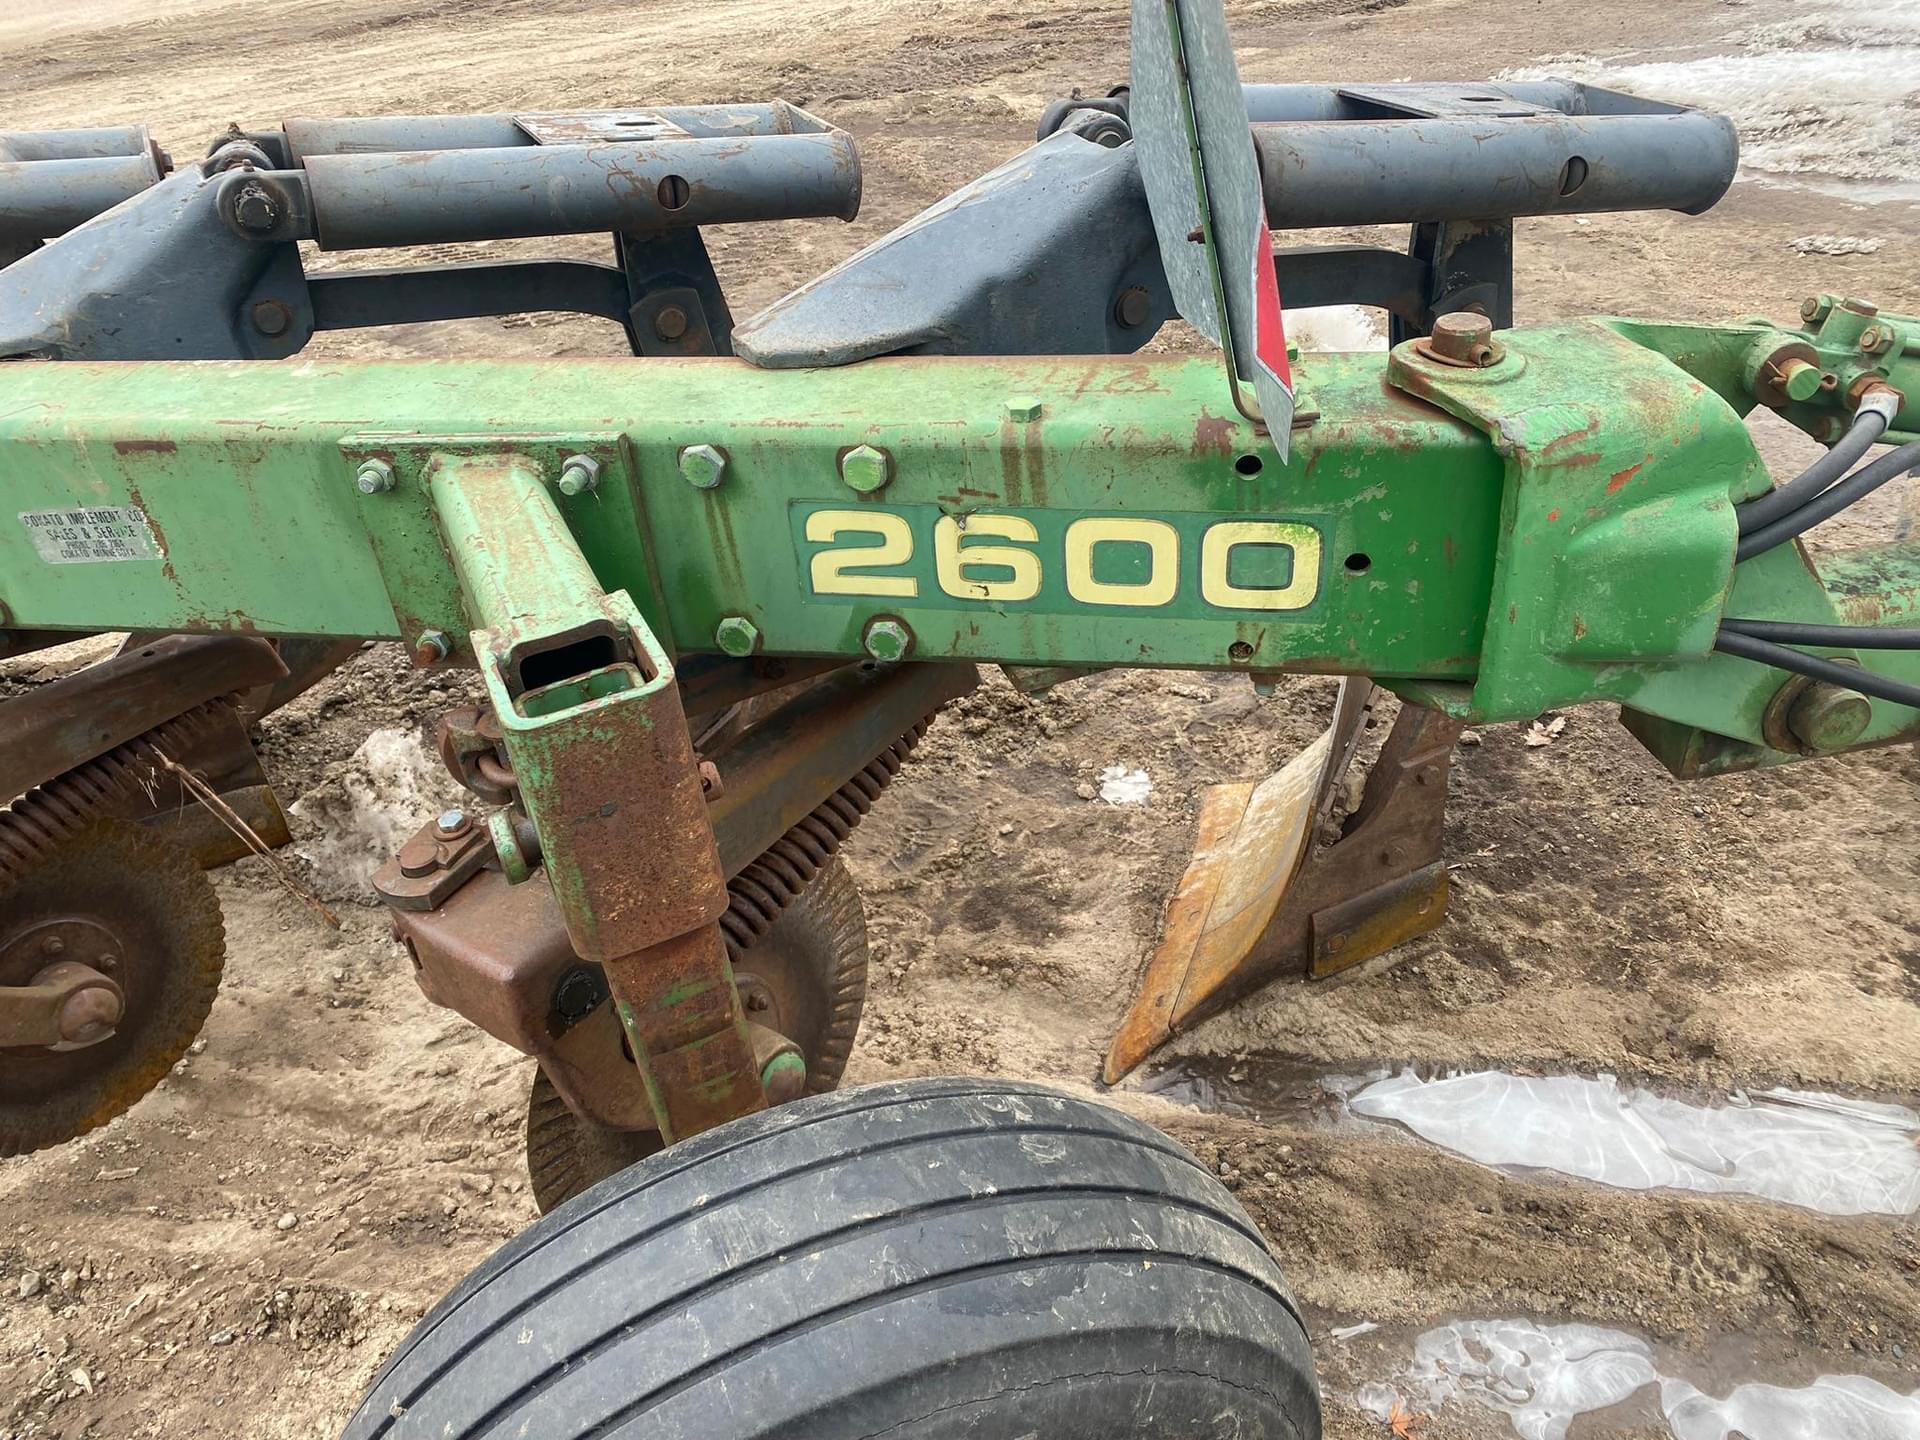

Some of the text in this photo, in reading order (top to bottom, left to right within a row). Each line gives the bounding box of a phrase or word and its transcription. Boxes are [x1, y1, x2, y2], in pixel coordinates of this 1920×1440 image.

[66, 511, 121, 525] IMPLEMENT
[46, 528, 77, 541] SALES
[81, 527, 91, 540] &
[805, 509, 1322, 610] 2600
